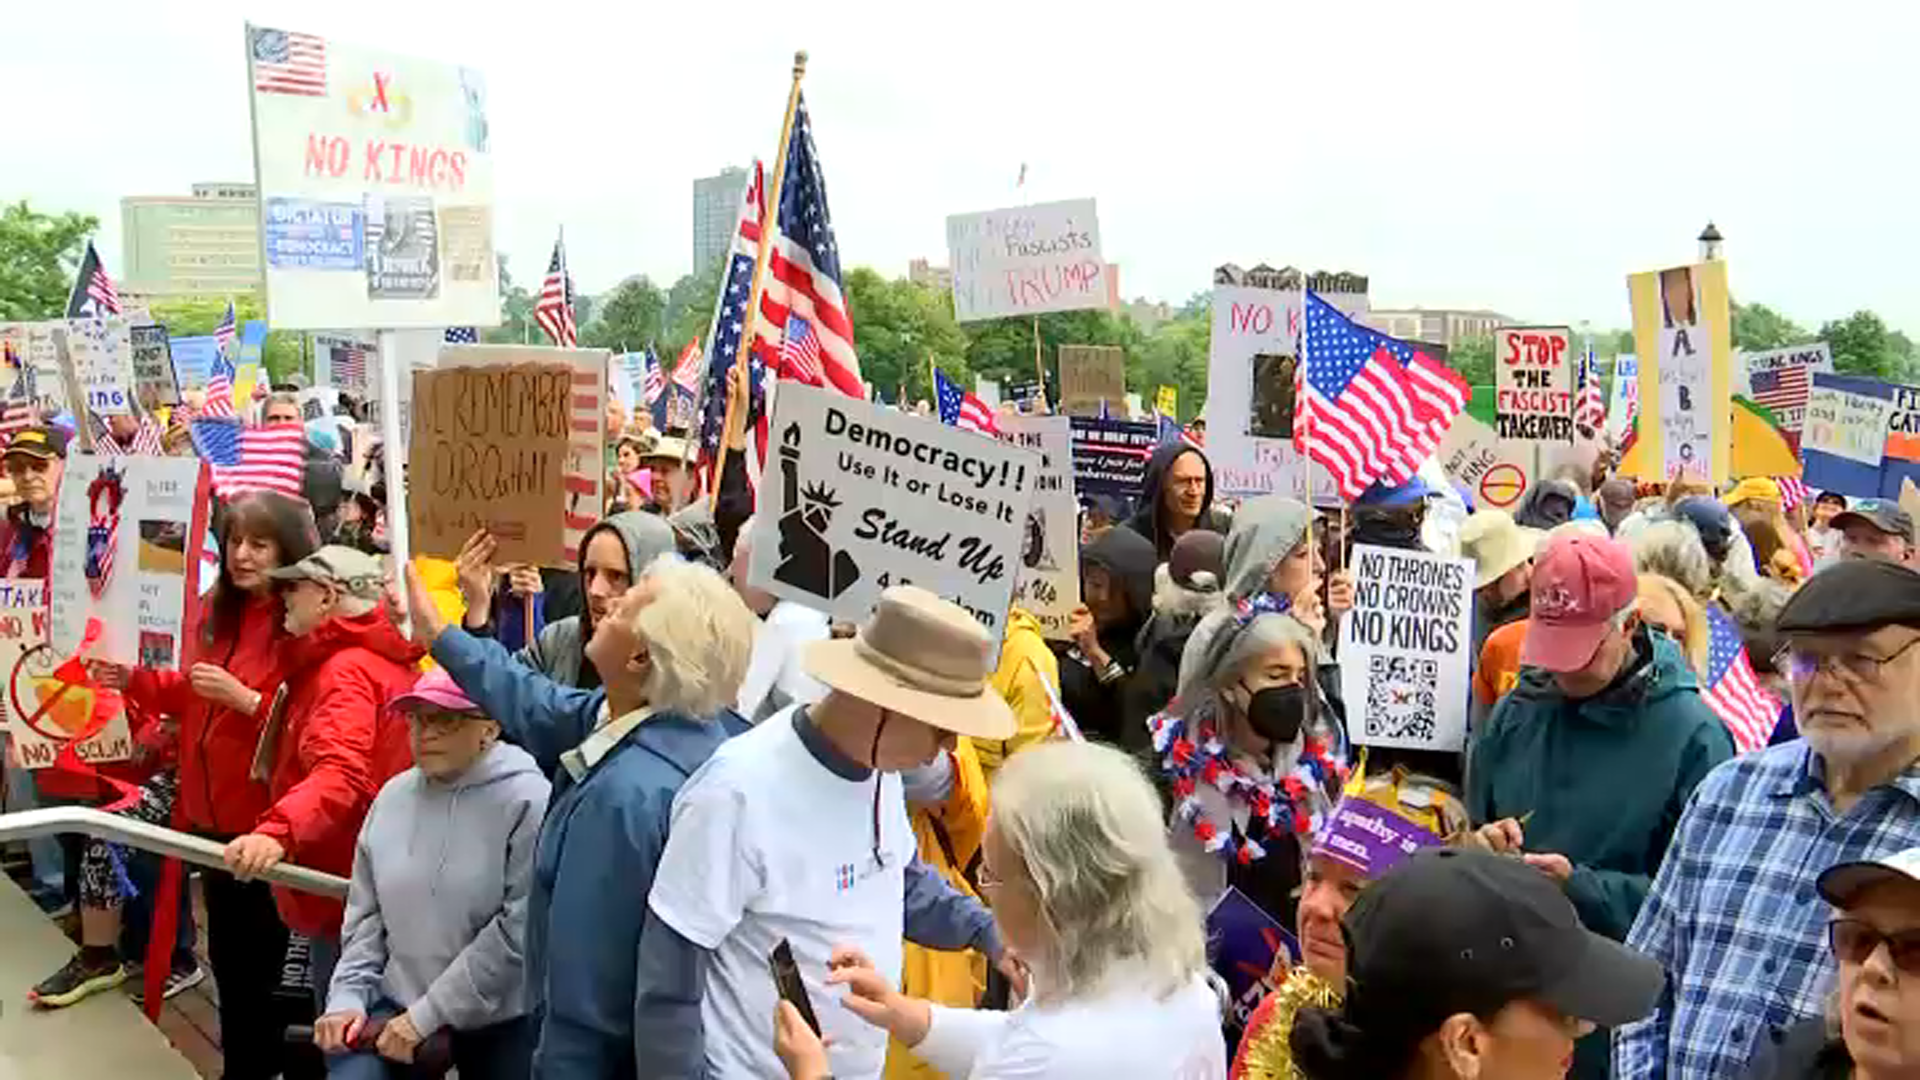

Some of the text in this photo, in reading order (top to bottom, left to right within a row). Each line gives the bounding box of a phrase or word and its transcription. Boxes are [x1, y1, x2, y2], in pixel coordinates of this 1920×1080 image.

[304, 131, 468, 190] NO KINGS
[1003, 260, 1100, 307] TRUMP
[1230, 302, 1275, 335] NO
[1503, 333, 1567, 365] STOP
[1671, 329, 1696, 357] A
[1512, 369, 1552, 388] THE
[1498, 390, 1570, 413] FASCIST
[825, 407, 1026, 491] Democracy!!
[1496, 413, 1574, 446] TAKEOVER
[1460, 447, 1497, 486] KING
[838, 451, 1014, 525] Use It or Lose It
[854, 507, 953, 562] Stand
[958, 537, 1005, 586] Up
[1359, 552, 1465, 592] NO THRONES
[1031, 578, 1057, 607] Up
[1353, 580, 1462, 619] NO CROWNS
[1350, 610, 1459, 655] NO KINGS
[21, 742, 51, 765] NO
[1400, 832, 1418, 854] is
